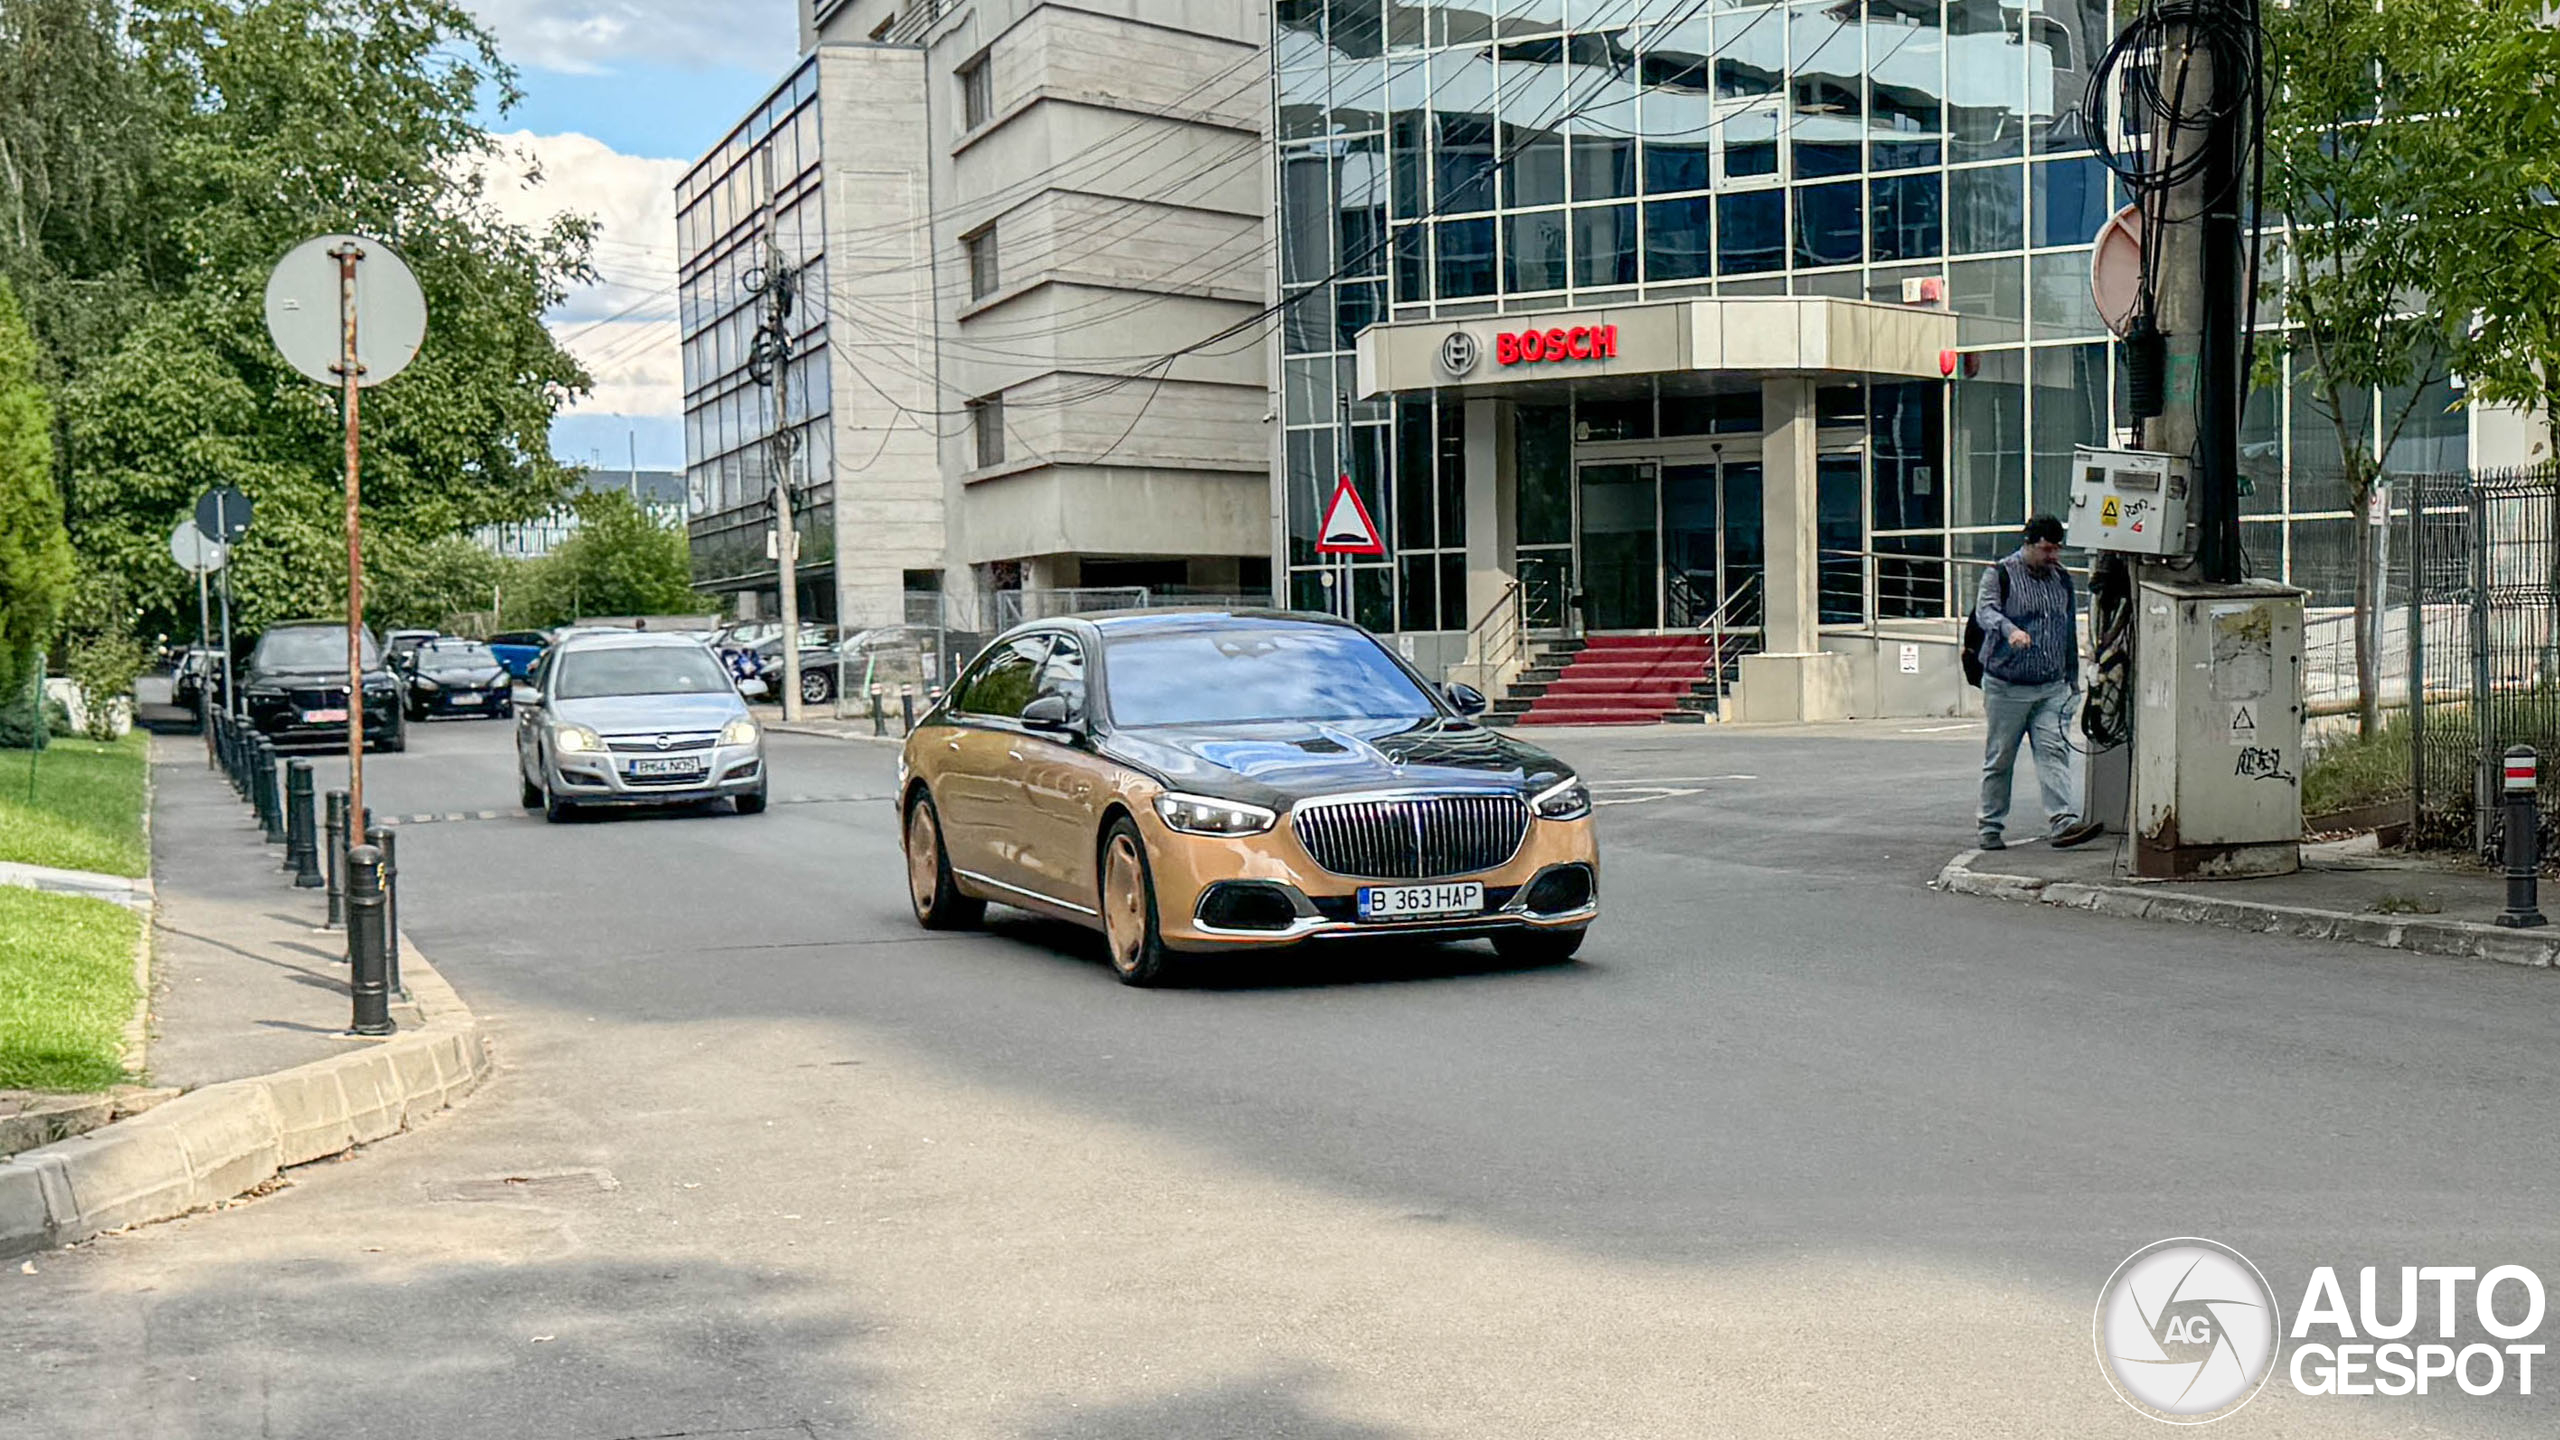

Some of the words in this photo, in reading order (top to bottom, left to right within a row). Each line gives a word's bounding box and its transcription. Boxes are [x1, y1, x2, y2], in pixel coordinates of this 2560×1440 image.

[1496, 324, 1617, 365] BOSCH
[1371, 890, 1386, 911] B
[1395, 888, 1432, 910] 363
[1436, 886, 1477, 908] HAP
